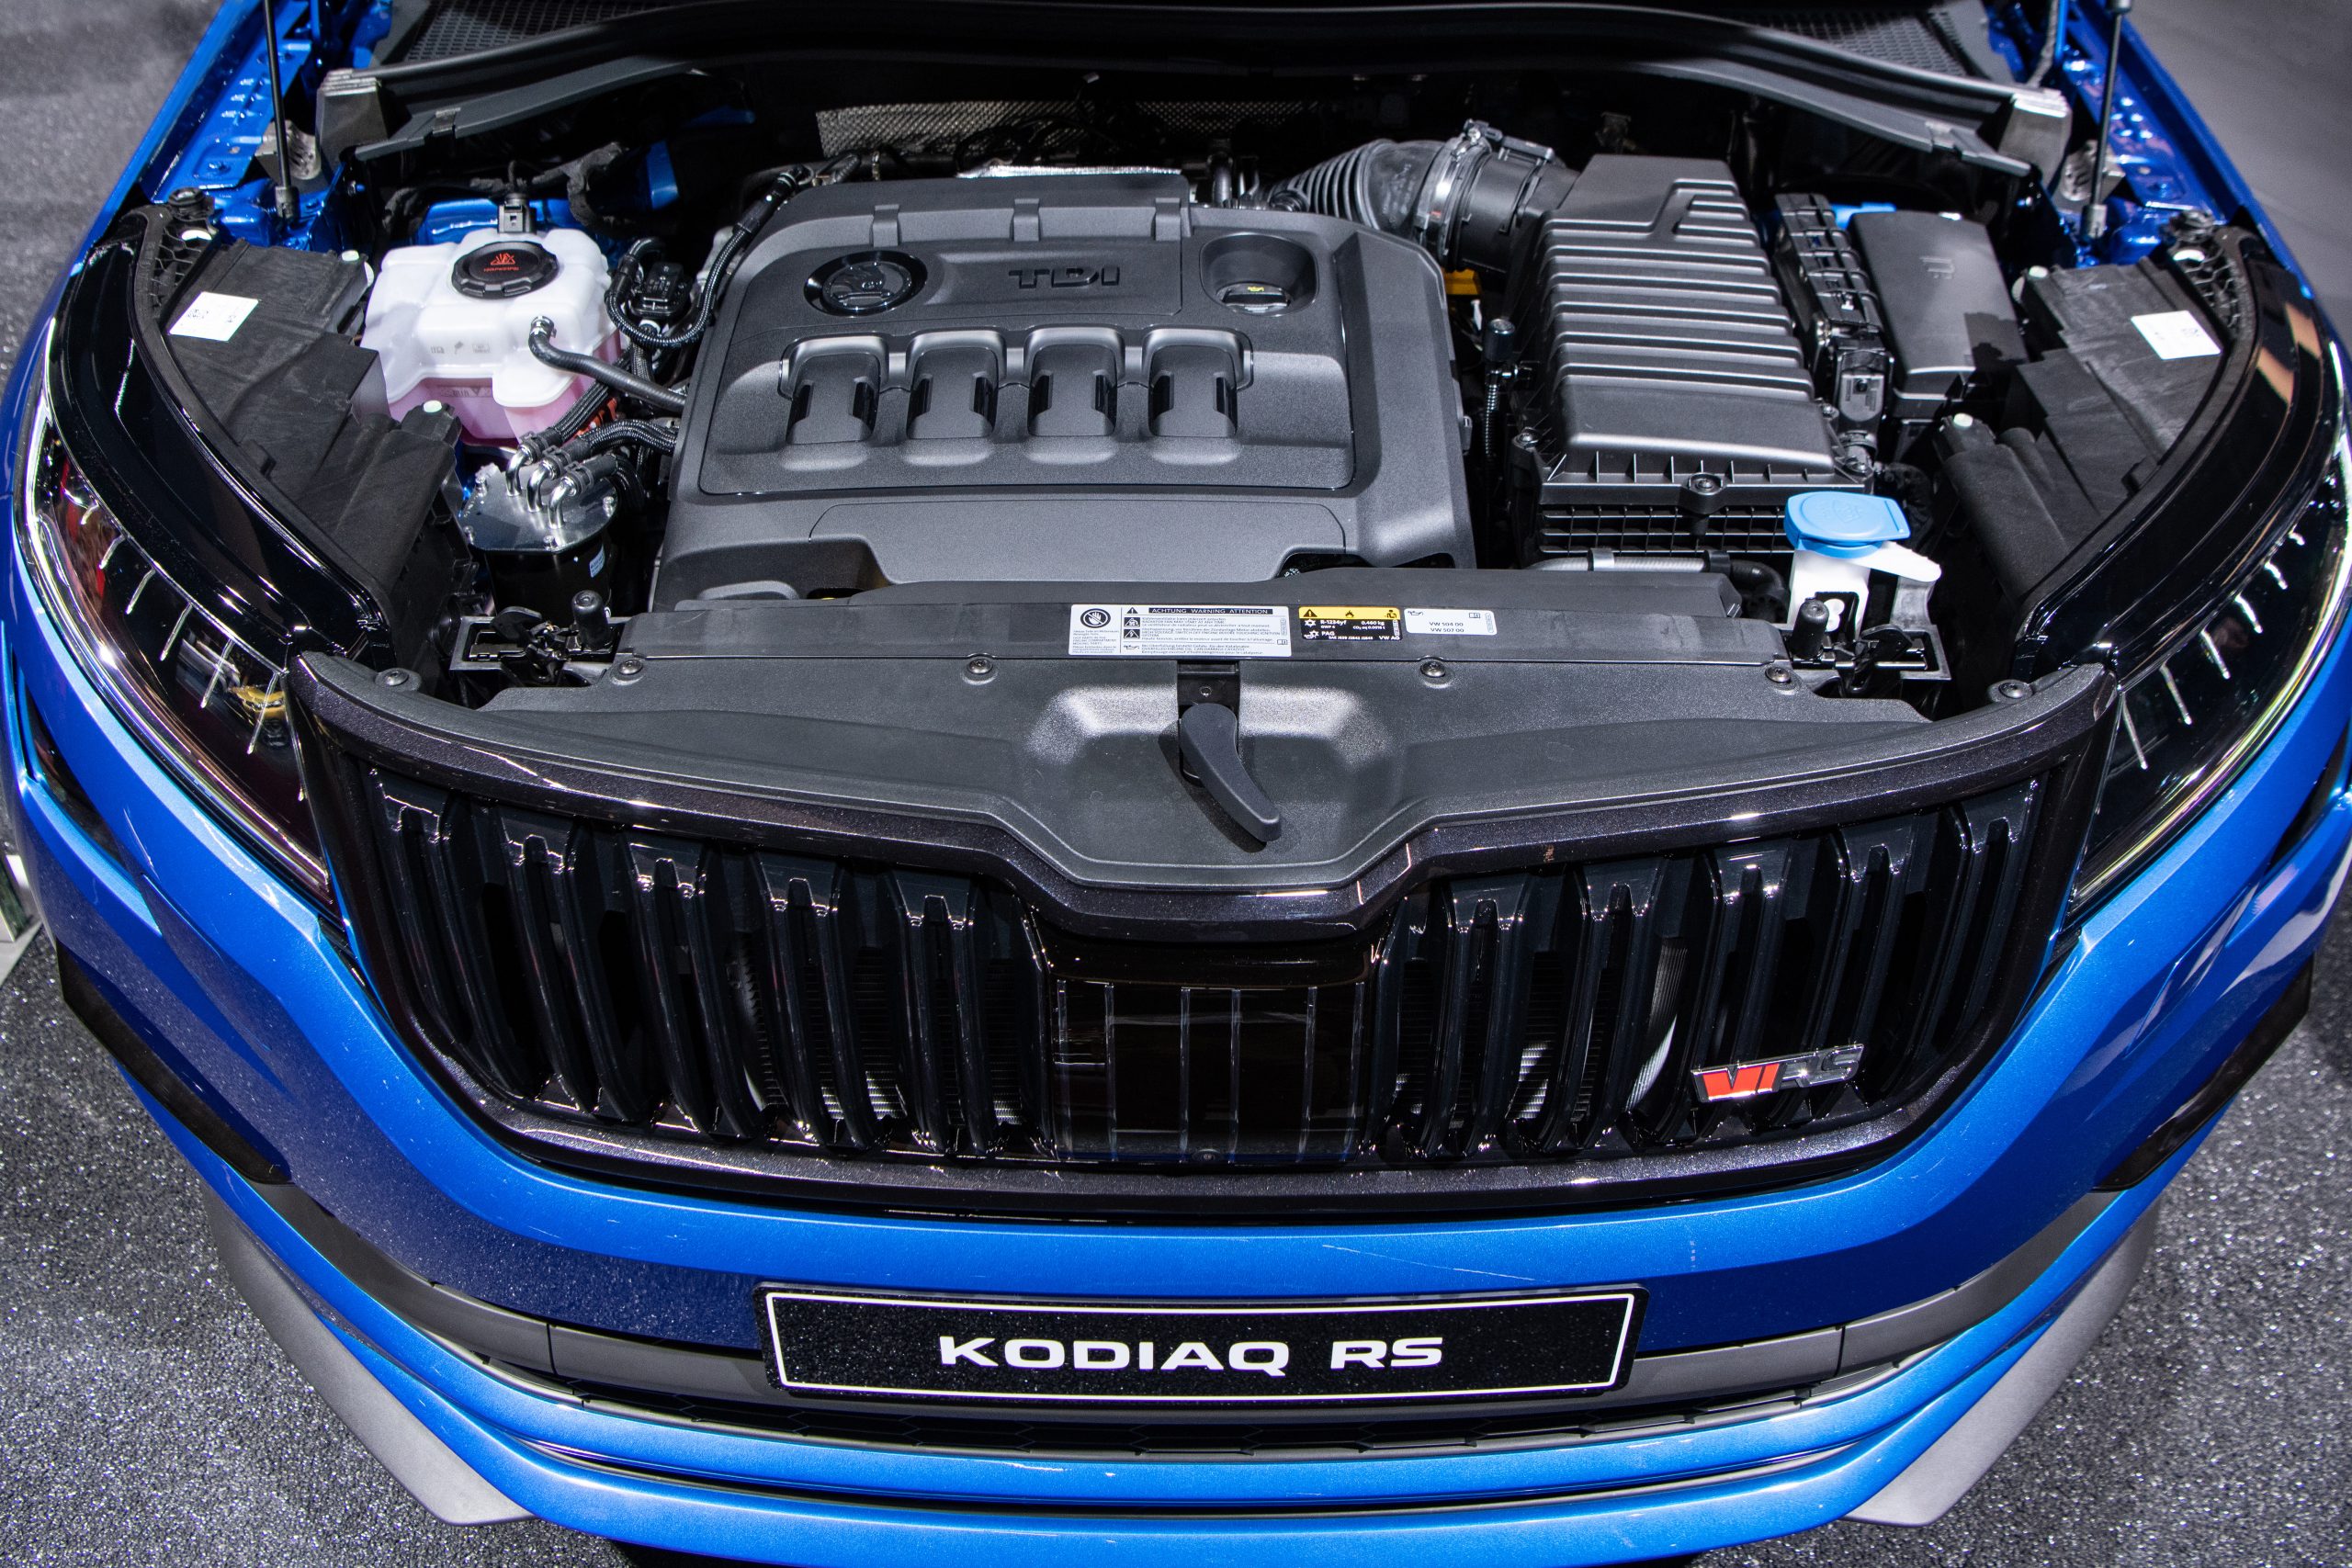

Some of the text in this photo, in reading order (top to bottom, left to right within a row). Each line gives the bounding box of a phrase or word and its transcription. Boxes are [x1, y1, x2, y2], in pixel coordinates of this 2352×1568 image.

[1009, 265, 1121, 290] TDI
[938, 1336, 1444, 1377] KODIAQ RS
